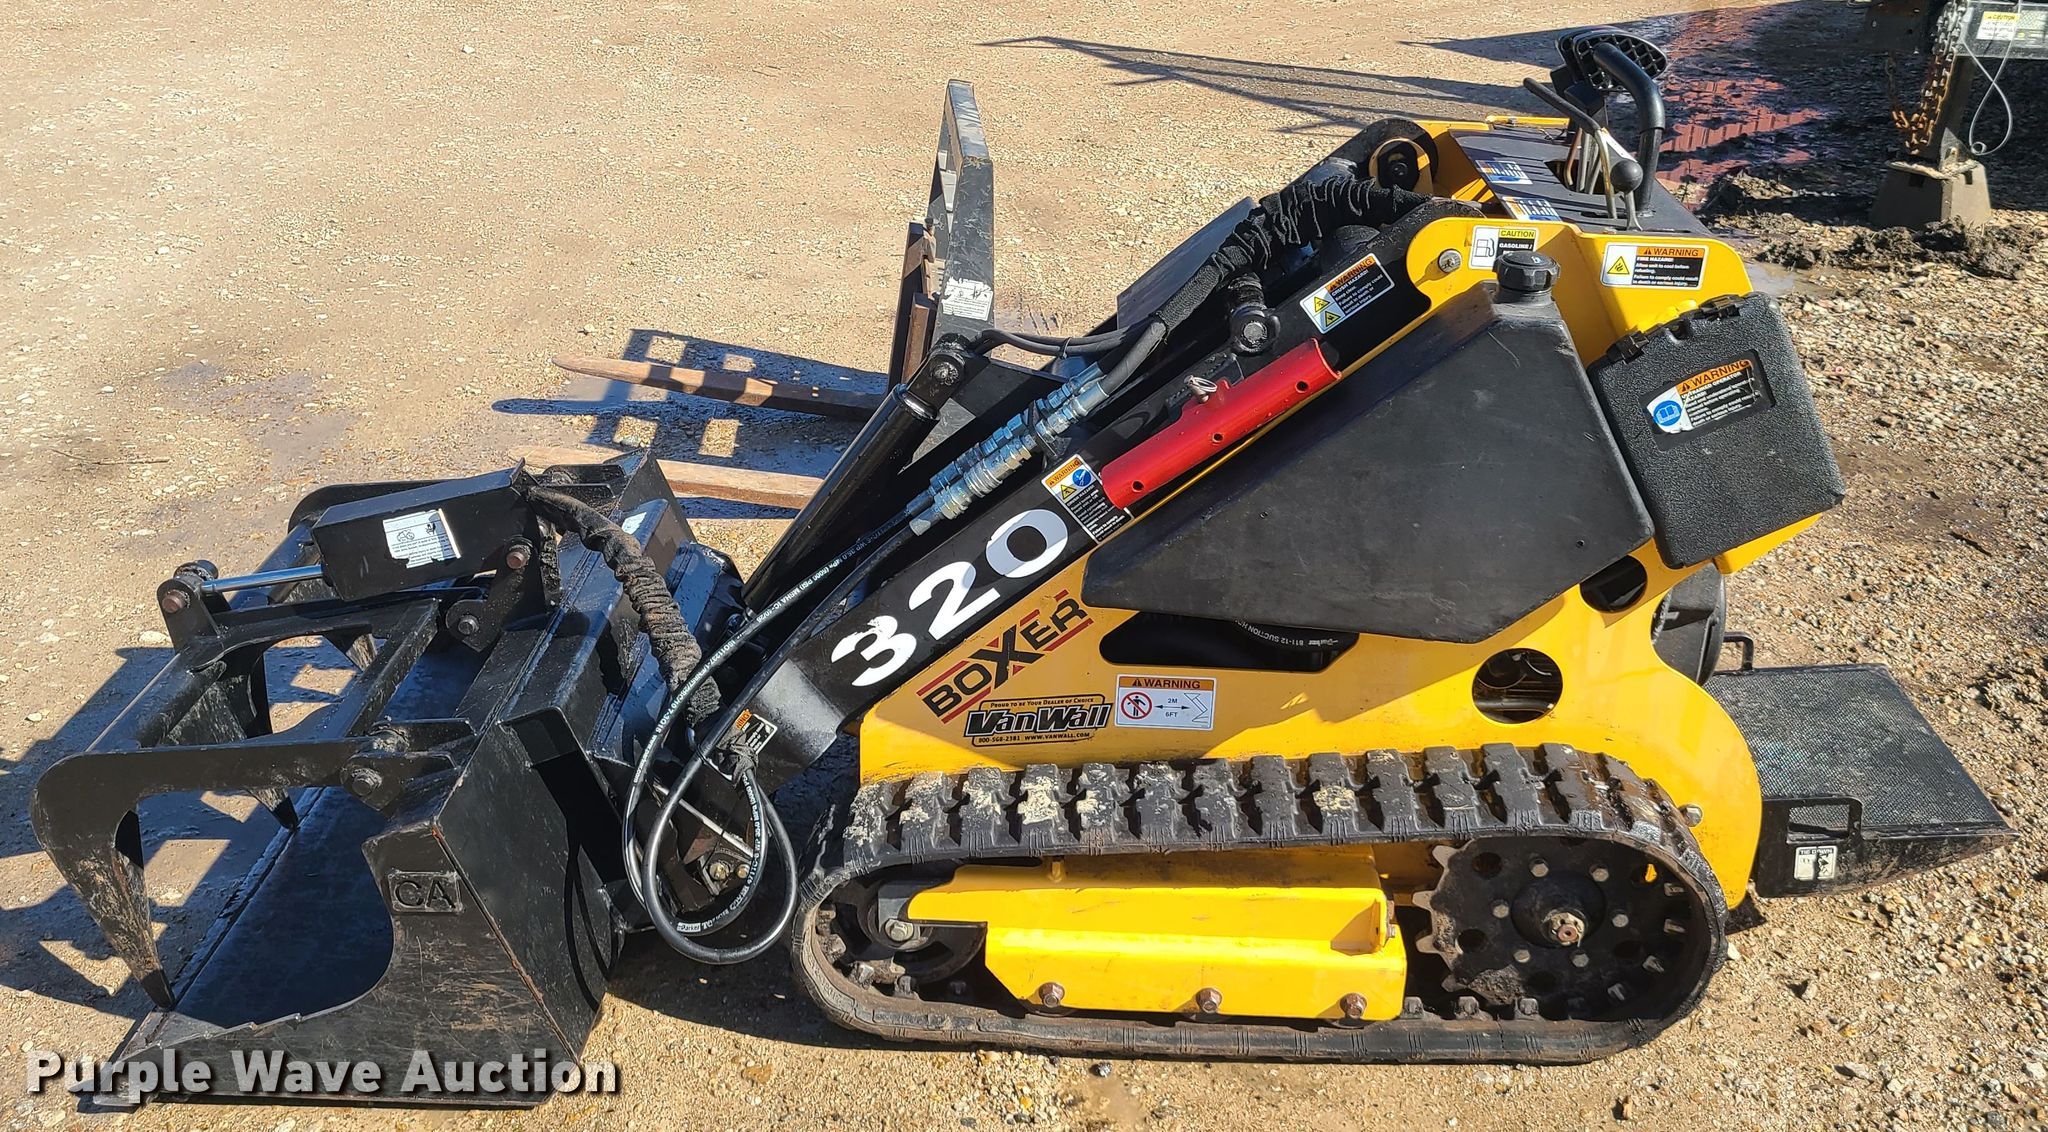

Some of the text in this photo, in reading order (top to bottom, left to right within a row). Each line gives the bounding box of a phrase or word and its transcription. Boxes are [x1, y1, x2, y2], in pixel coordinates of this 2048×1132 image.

[1653, 247, 1698, 256] WARNING
[1337, 258, 1371, 284] WARNING
[1692, 360, 1750, 386] WARNING
[1053, 460, 1079, 481] WARNING
[830, 508, 1068, 686] 320
[1248, 626, 1279, 643] SUCTION
[922, 598, 1088, 717] BOXER
[1144, 678, 1200, 689] WARNING
[965, 704, 1112, 736] VanWall
[1024, 732, 1090, 740] WWW.VANWALL.COM
[394, 880, 456, 908] CA
[680, 924, 700, 932] Parker
